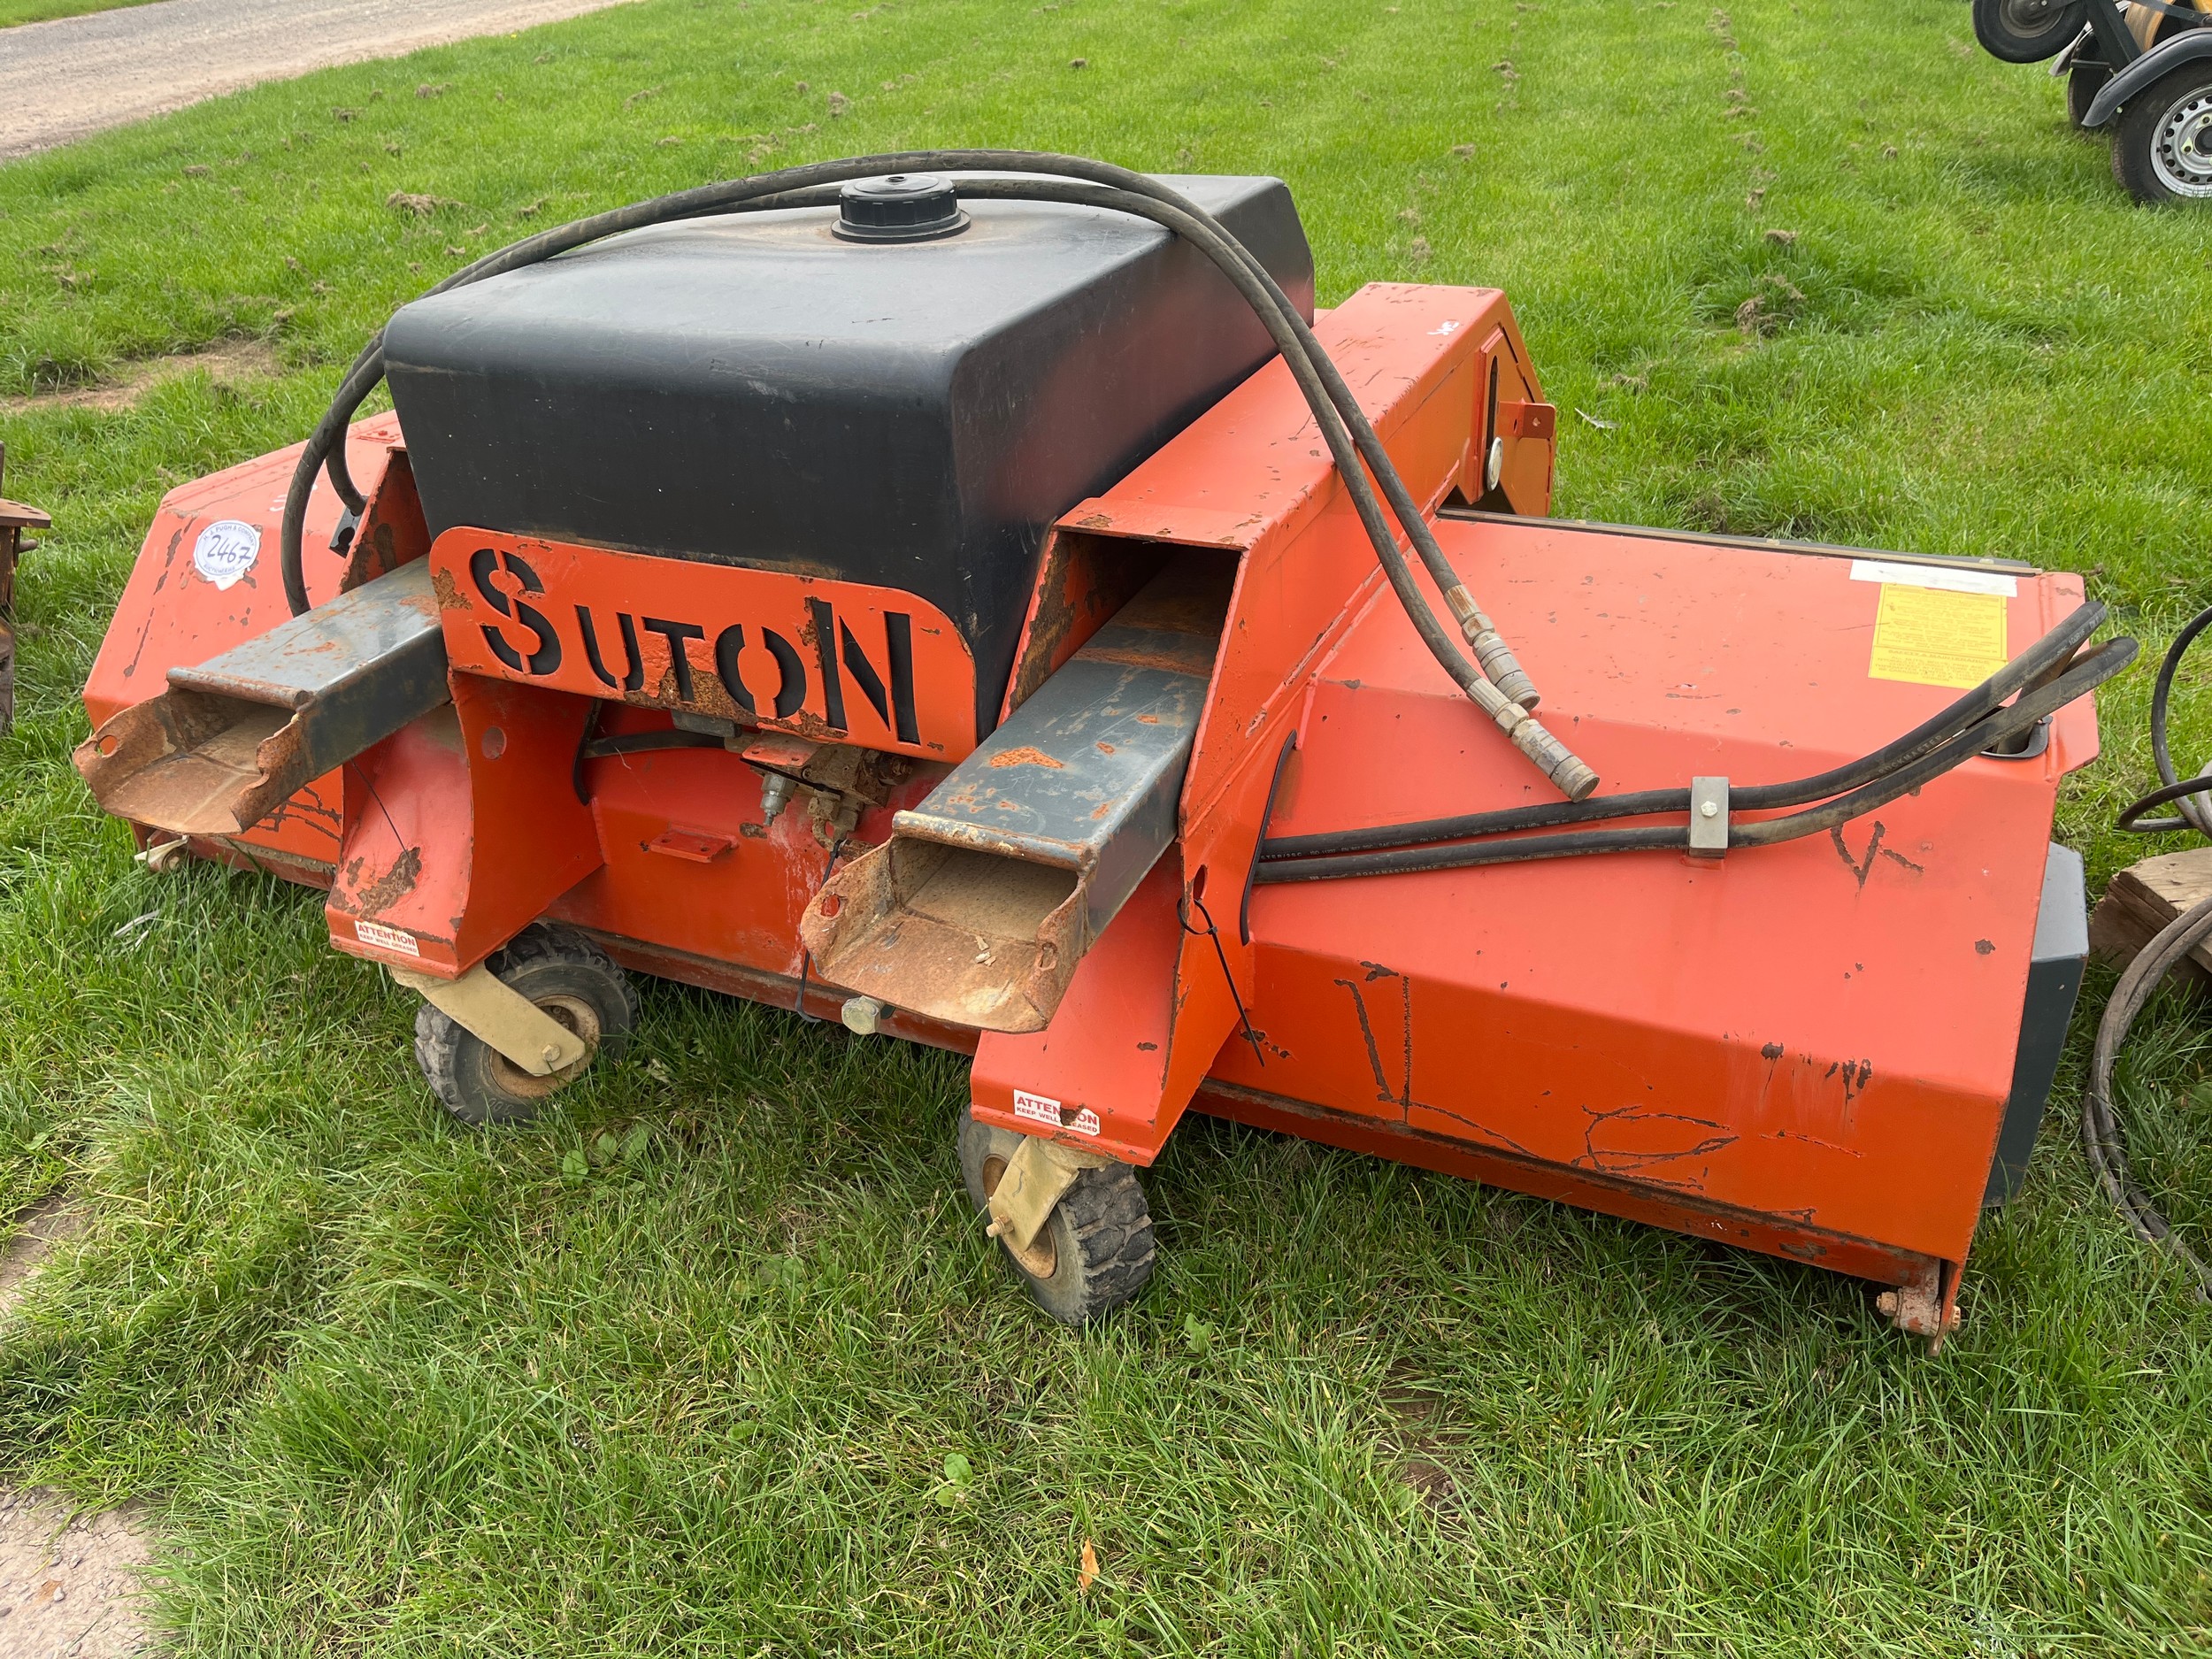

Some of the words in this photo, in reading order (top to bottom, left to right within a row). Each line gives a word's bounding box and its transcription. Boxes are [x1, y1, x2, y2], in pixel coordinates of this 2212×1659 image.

[207, 534, 251, 565] 2467
[237, 526, 255, 546] COMPANY
[468, 546, 922, 746] SUTON
[1878, 733, 1943, 775] ROCKMASTER
[358, 924, 416, 947] ATTENTION
[359, 933, 374, 941] KEEP
[375, 937, 390, 947] WELL
[391, 941, 418, 953] GREASED
[1016, 1106, 1037, 1116] KEEP
[1038, 1111, 1058, 1124] WELL
[1017, 1095, 1098, 1126] ATTENON
